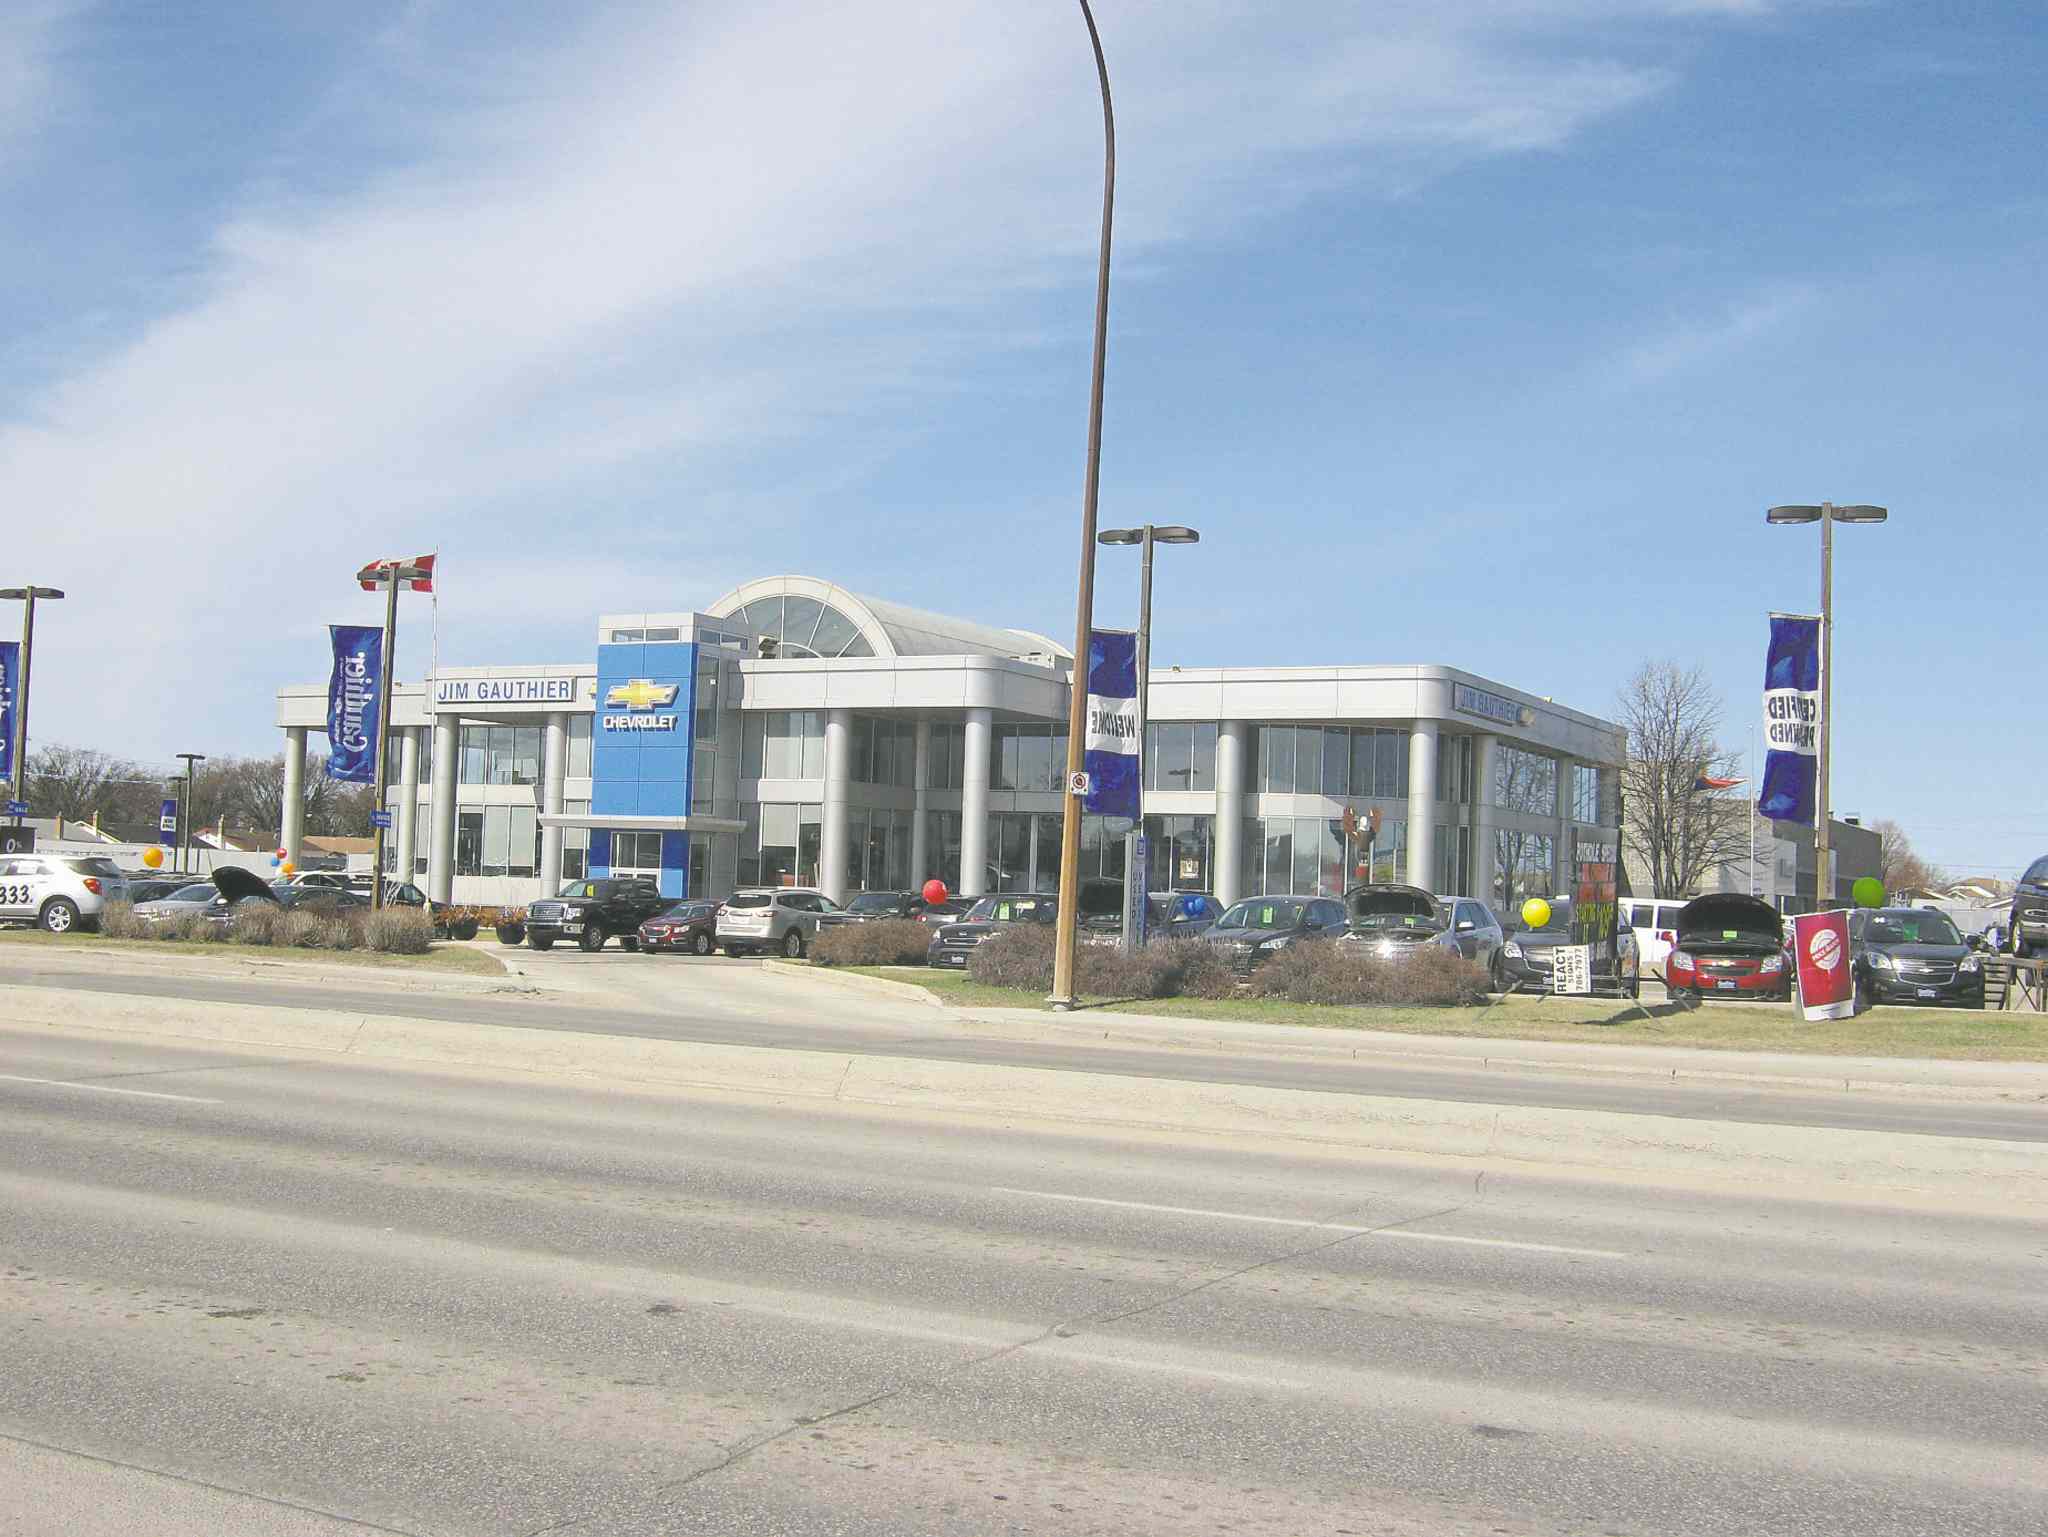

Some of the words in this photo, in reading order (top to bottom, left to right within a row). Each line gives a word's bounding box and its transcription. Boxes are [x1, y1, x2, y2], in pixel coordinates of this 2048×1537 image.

[439, 682, 469, 700] JIM
[477, 681, 569, 699] GAUTHIER
[603, 715, 677, 730] CHEVROLET
[1556, 947, 1567, 992] REACT
